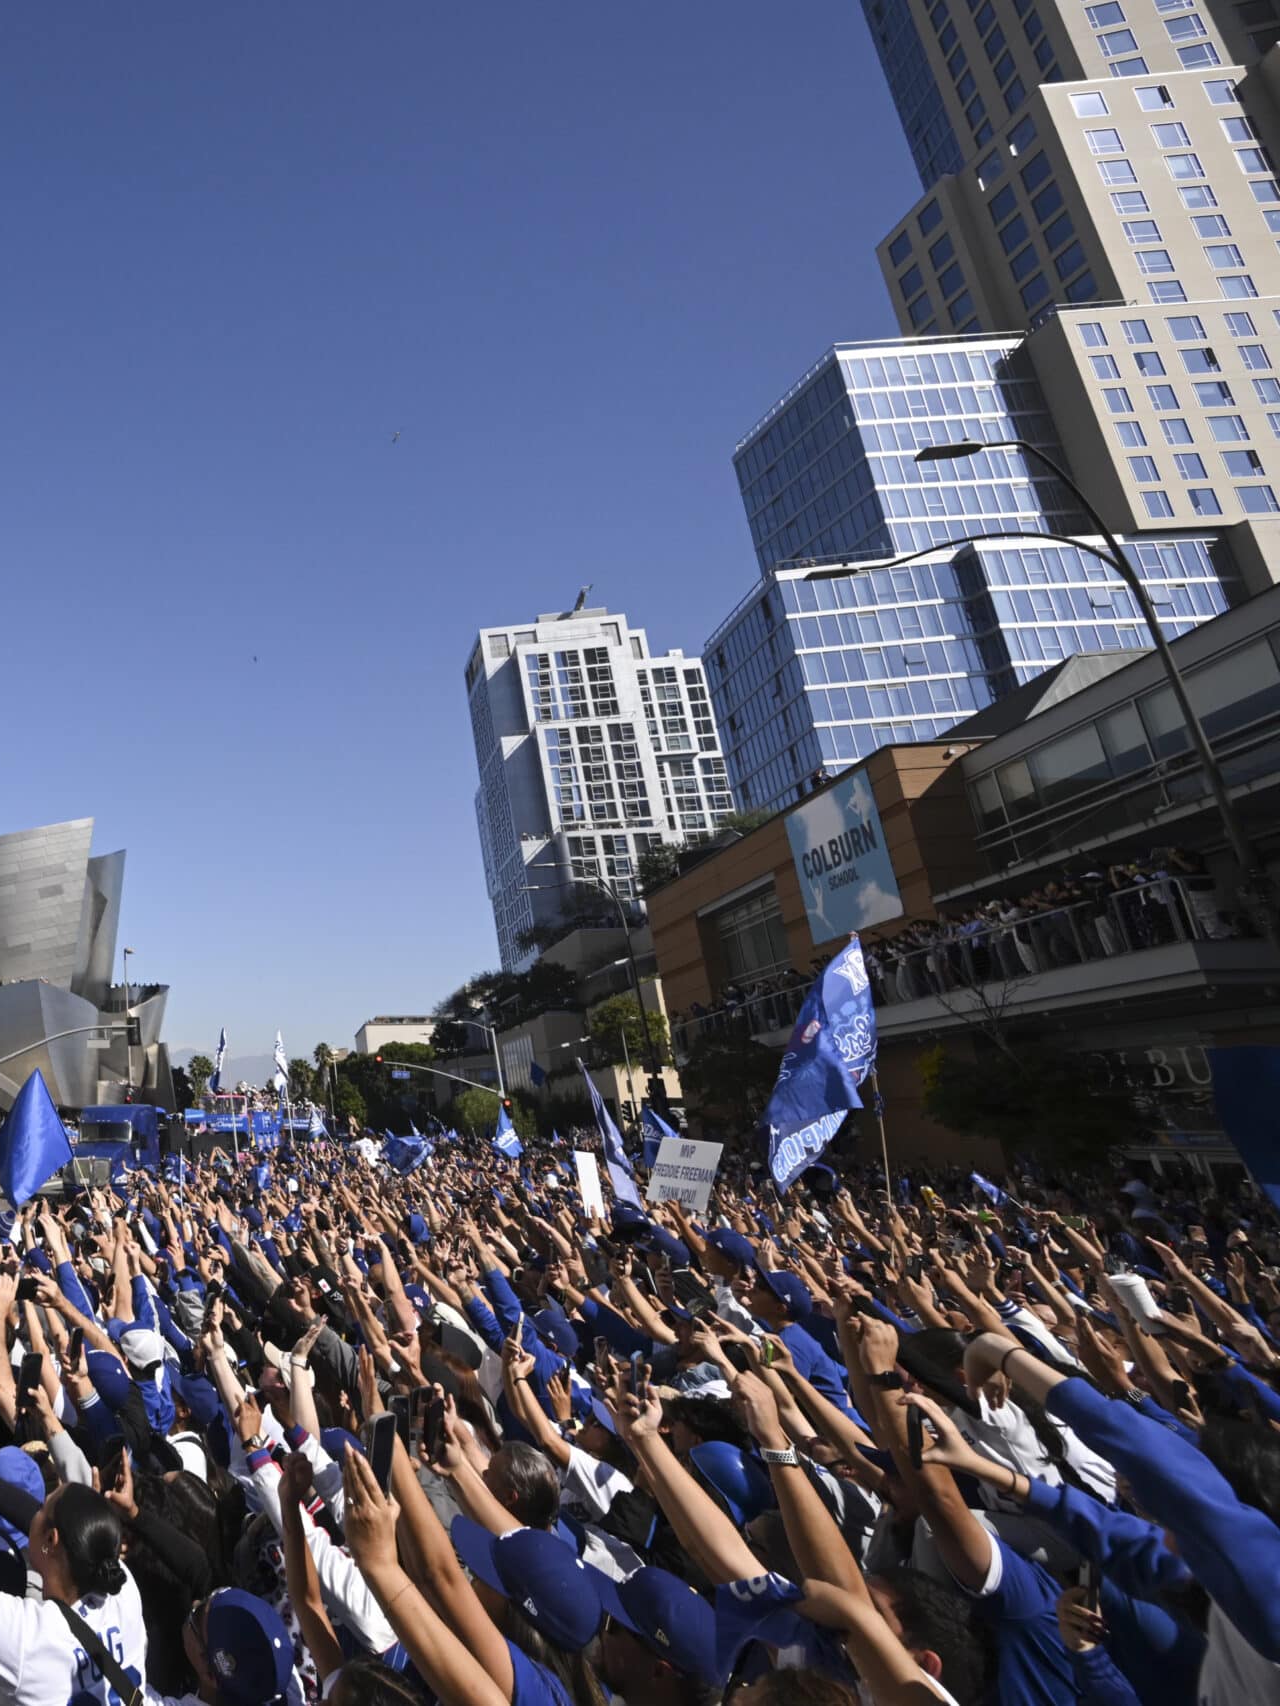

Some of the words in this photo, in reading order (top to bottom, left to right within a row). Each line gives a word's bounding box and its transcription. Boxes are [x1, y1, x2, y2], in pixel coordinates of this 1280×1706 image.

[802, 819, 878, 880] COLBURN
[827, 867, 859, 891] SCHOOL
[680, 1144, 696, 1158] MVP
[655, 1163, 681, 1180] FREDDIE
[680, 1166, 714, 1184] FREEMAN
[658, 1184, 679, 1200] THANK
